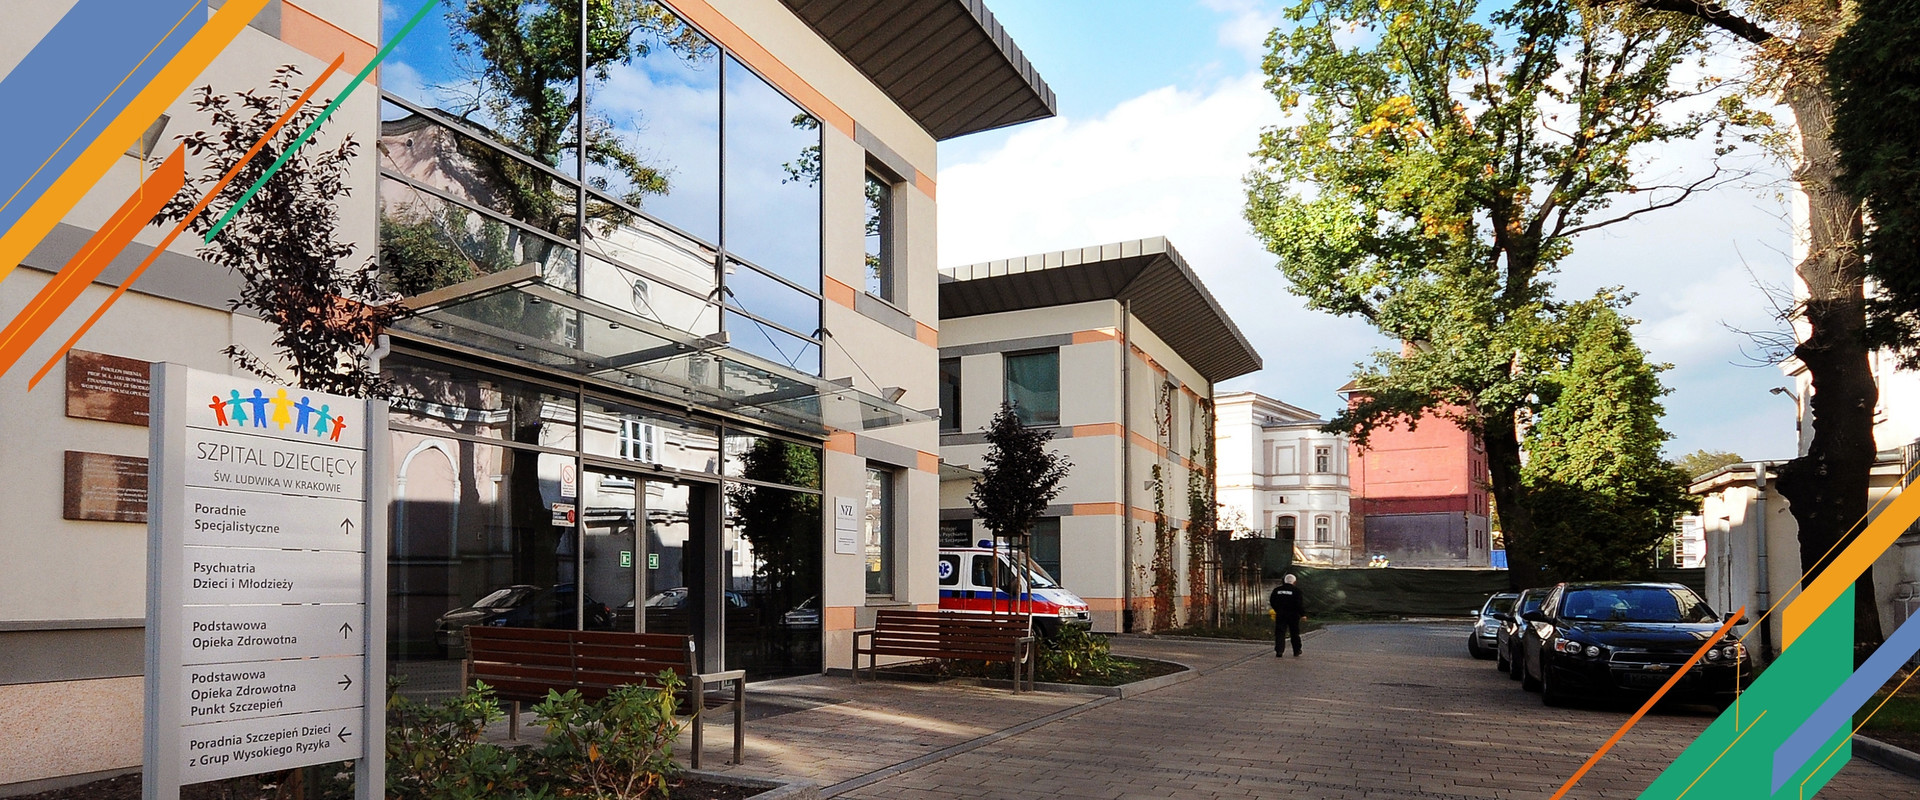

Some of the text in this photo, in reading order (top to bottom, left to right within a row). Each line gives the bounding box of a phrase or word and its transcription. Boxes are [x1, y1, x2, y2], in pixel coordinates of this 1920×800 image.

[197, 442, 357, 478] SZPITAL DZIECIĘCY
[214, 470, 341, 492] ŚW. LUDWIKA W KRAKOWIE
[195, 503, 246, 516] Poradnie
[194, 519, 280, 534] Specjalistyczne
[193, 562, 256, 575] Psychiatria
[193, 578, 294, 591] Dzieci i Młodzieży
[193, 621, 267, 632] Podstawowa
[192, 635, 297, 650] Opieka Zdrowotna
[192, 671, 266, 684] Podstawowa
[191, 684, 296, 702] Opieka Zdrowotna
[191, 698, 283, 716] Punkt Szczepień
[190, 723, 331, 750] Poradnia Szczepień Dzieci
[190, 739, 330, 767] z Grup Wysokiego Ryzyka
